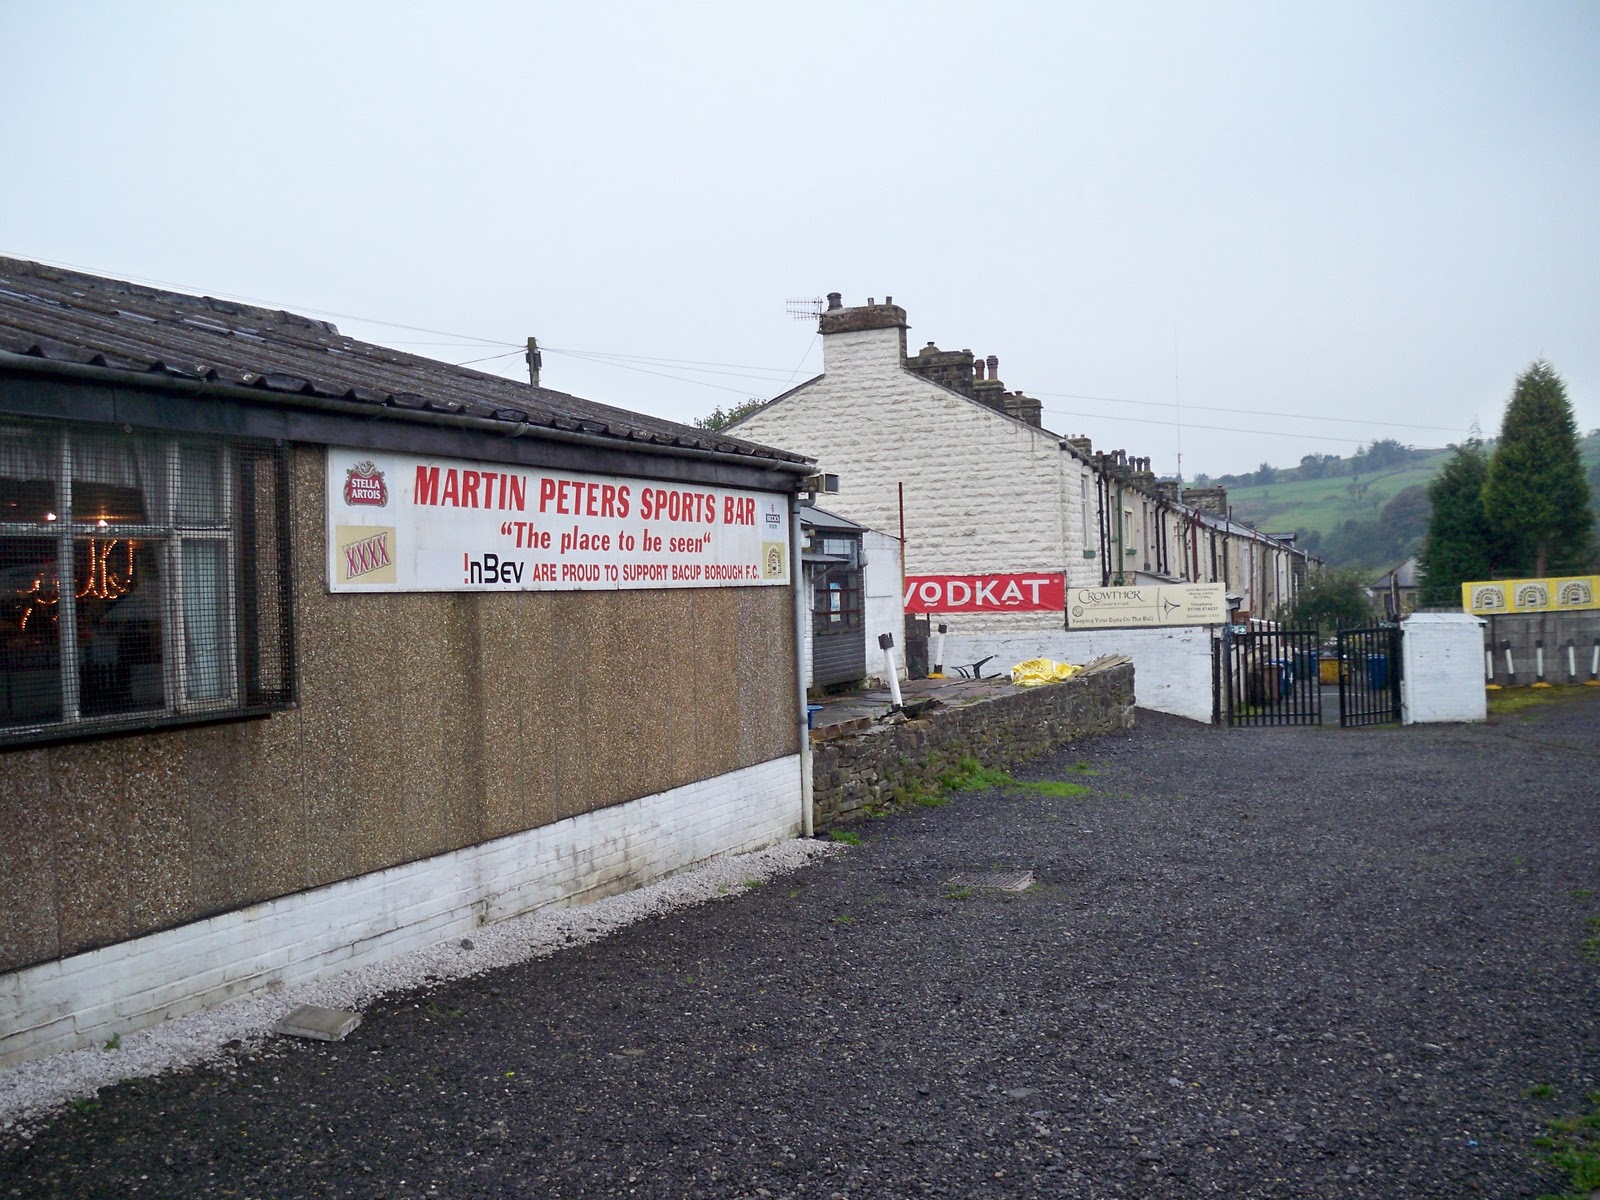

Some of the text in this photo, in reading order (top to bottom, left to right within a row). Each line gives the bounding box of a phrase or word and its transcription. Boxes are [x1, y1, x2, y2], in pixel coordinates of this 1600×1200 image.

[352, 478, 380, 489] STELLA
[352, 489, 381, 499] ARTOIS
[414, 465, 756, 526] MARTIN PETERS SPORTS BAR
[560, 525, 611, 554] place
[618, 530, 635, 551] to
[642, 528, 662, 552] be
[342, 532, 391, 579] XXXX
[532, 563, 557, 581] ARE
[562, 563, 600, 581] PROUD
[604, 564, 619, 581] TO
[622, 564, 668, 581] SUPPORT
[672, 564, 701, 581] BACUP
[704, 565, 743, 580] BOROUGH
[1078, 589, 1146, 604] CROWTHER
